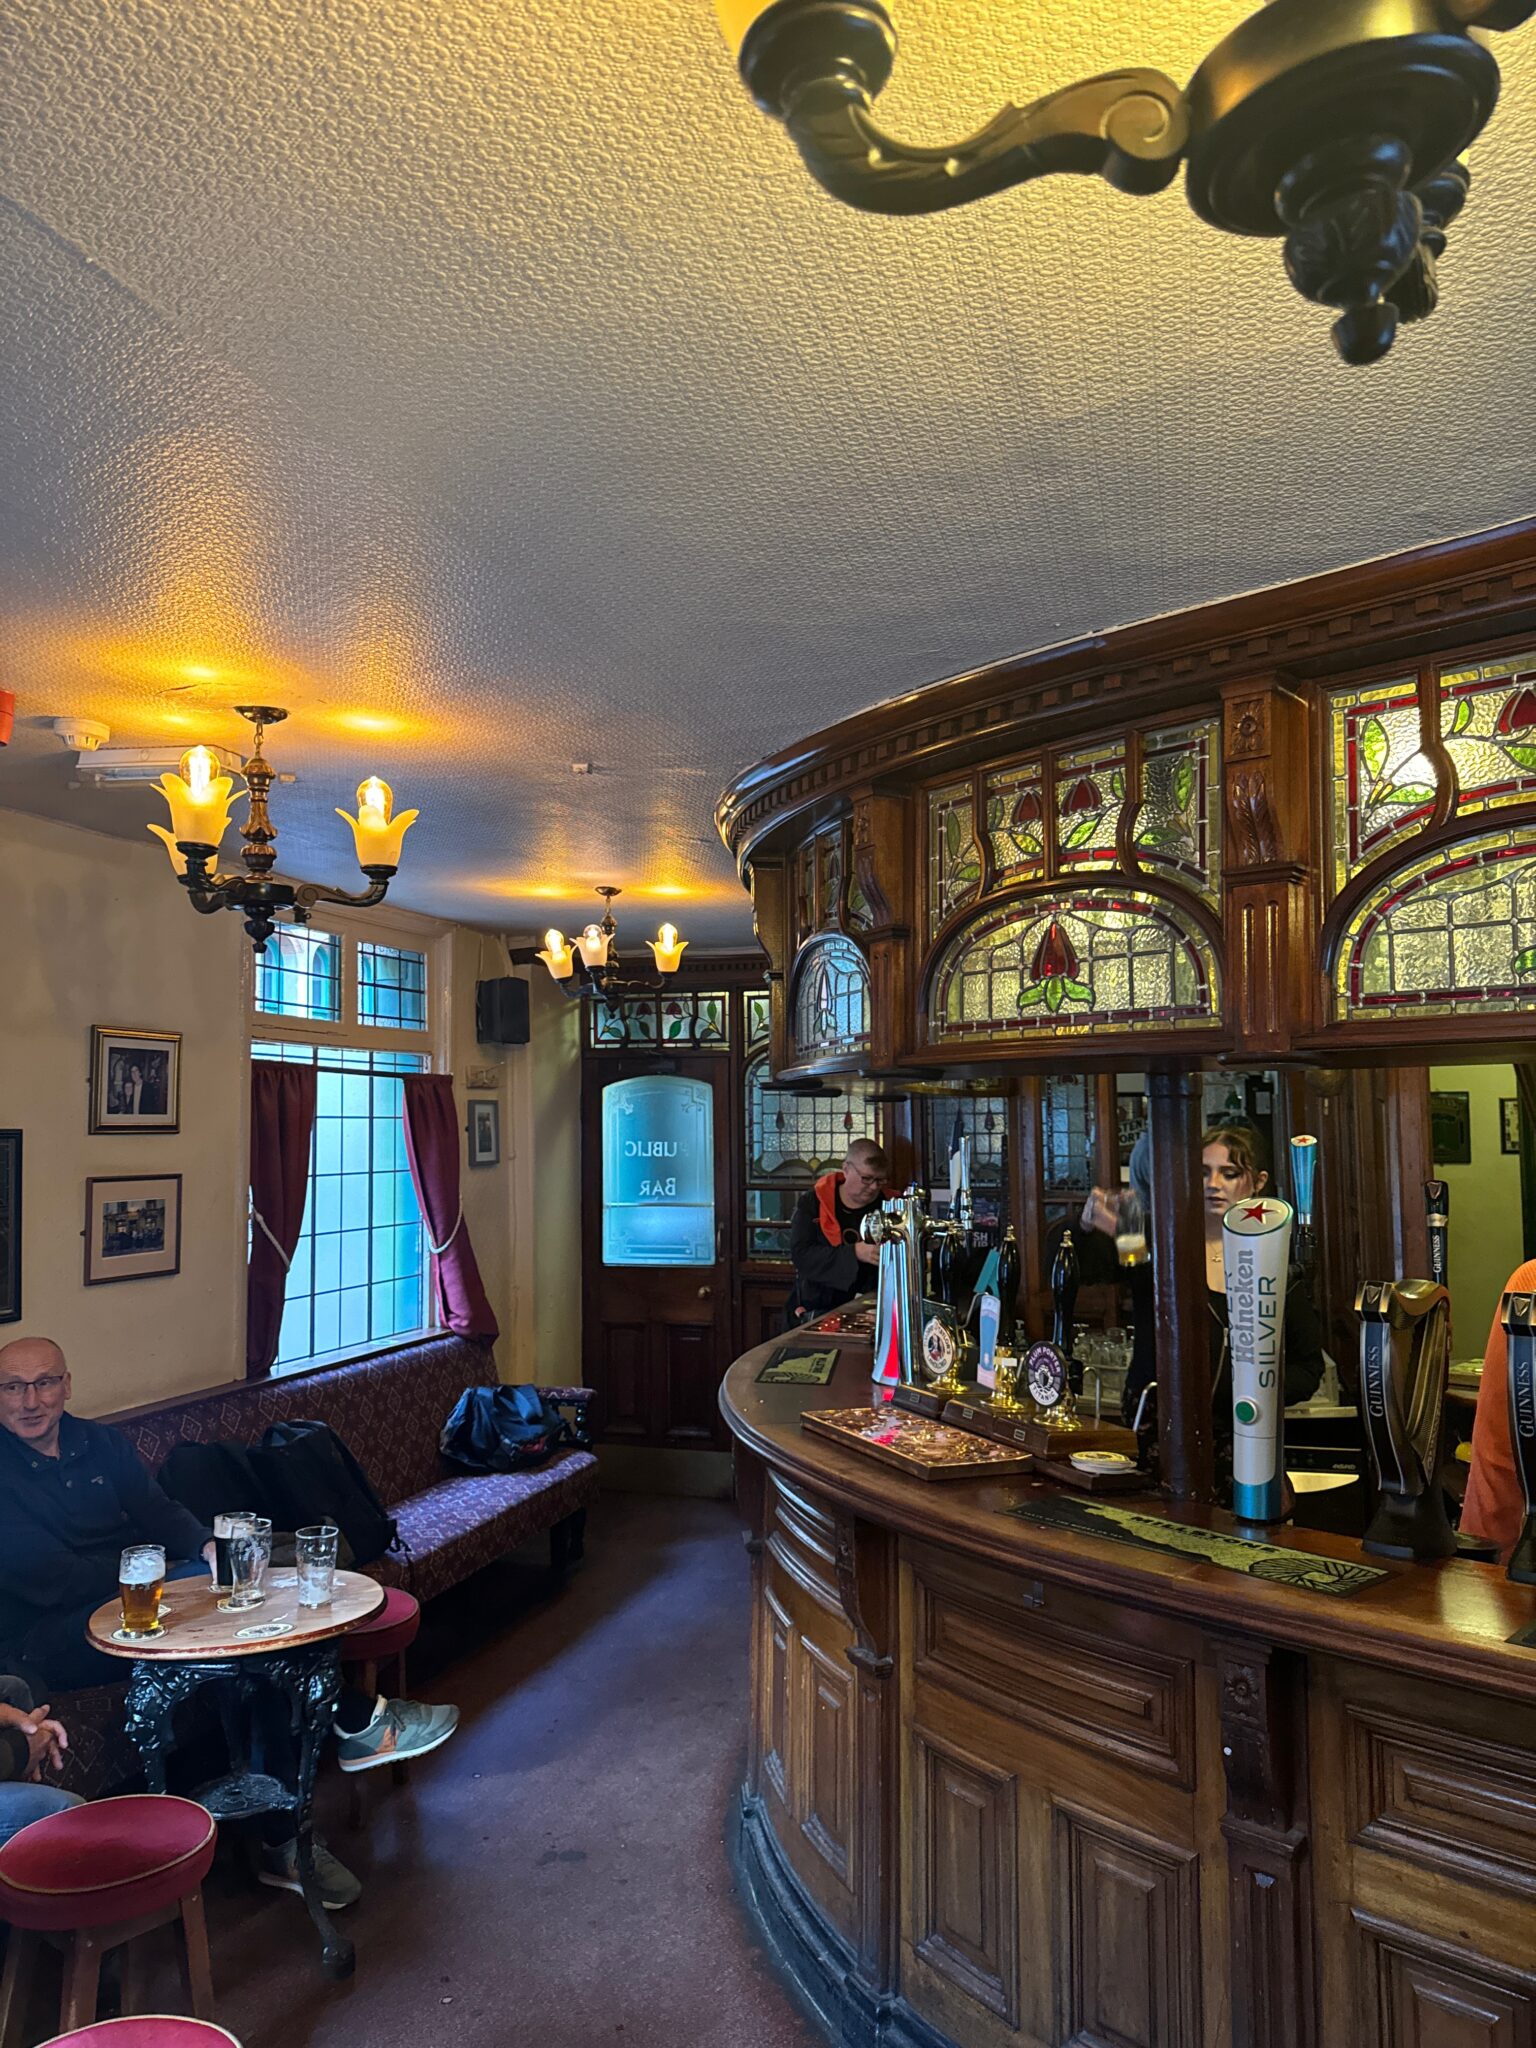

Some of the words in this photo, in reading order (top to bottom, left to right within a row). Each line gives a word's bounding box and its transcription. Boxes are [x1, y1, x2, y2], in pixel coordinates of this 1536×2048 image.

[1432, 1234, 1442, 1273] GUINNESS
[1234, 1249, 1254, 1365] Heineken
[1258, 1276, 1276, 1388] SILVER
[1367, 1345, 1384, 1417] GUINNESS
[1516, 1361, 1535, 1437] GUINNESS
